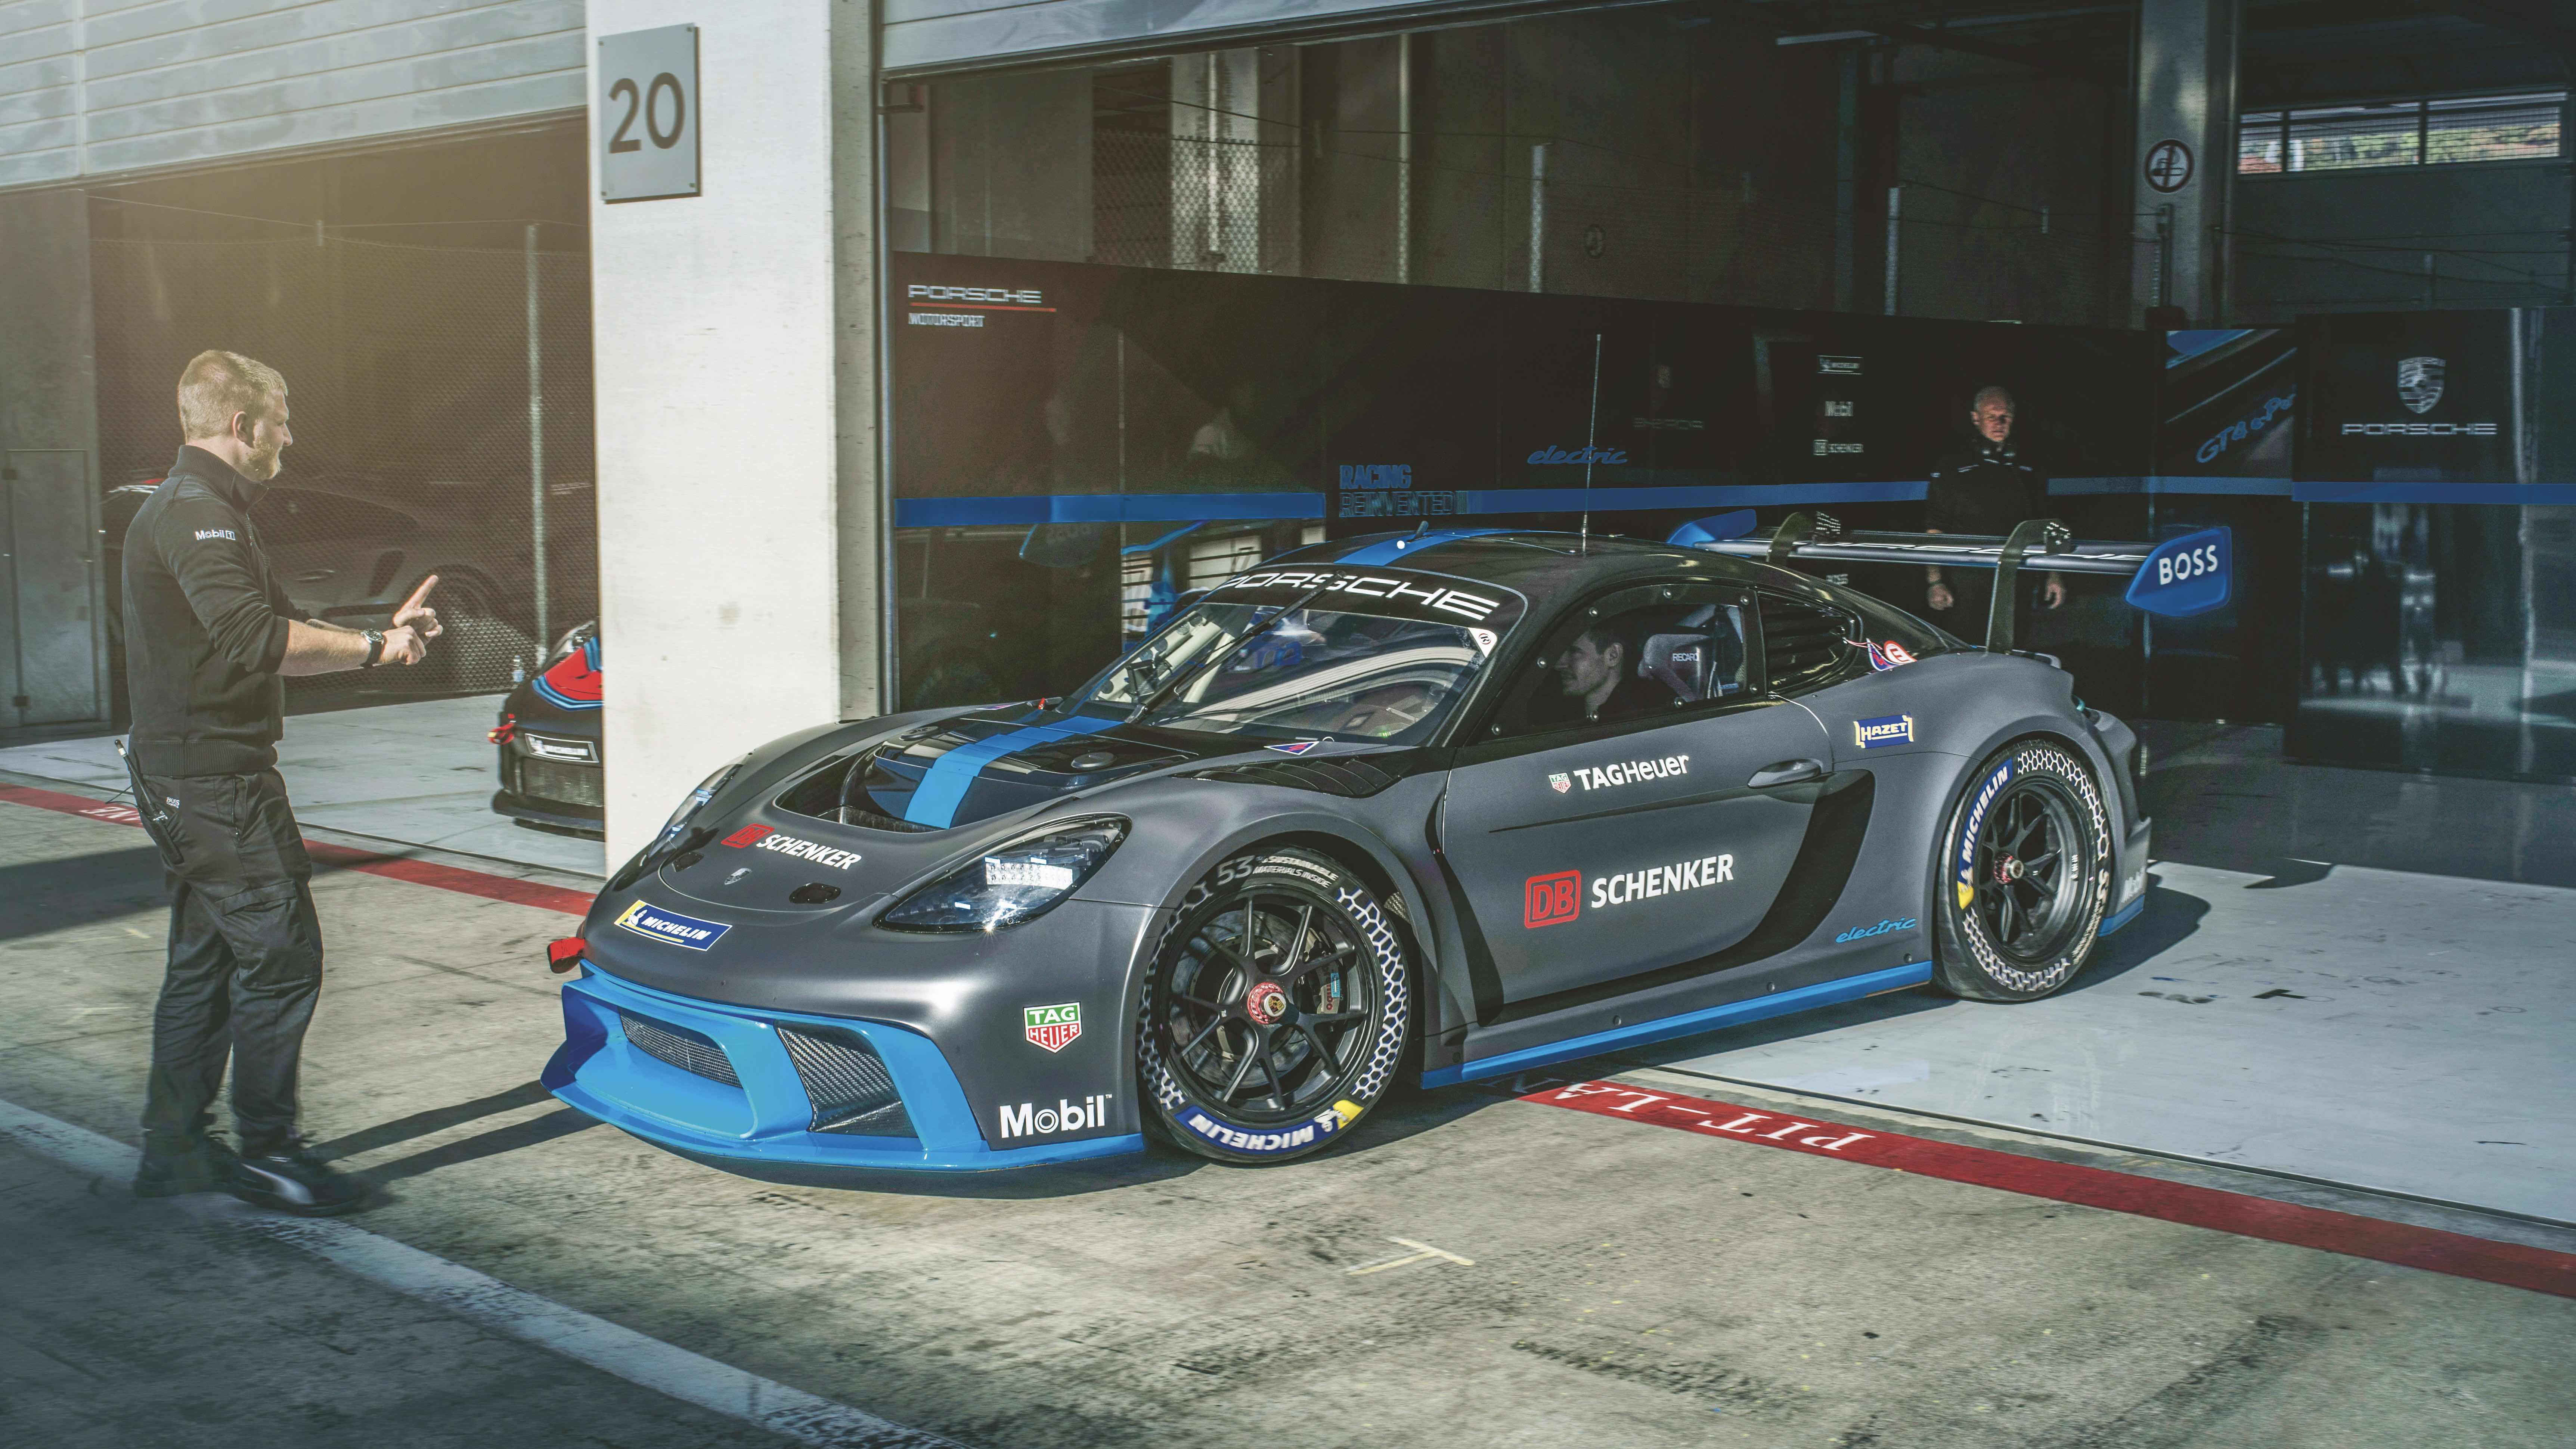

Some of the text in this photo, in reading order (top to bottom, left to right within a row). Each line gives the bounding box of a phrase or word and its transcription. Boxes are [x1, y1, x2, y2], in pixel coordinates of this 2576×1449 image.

[608, 72, 685, 154] 20
[908, 285, 1042, 303] PORSCHE
[2342, 423, 2497, 435] PORSCHE
[1527, 446, 1627, 464] electric
[1339, 465, 1411, 489] RACING
[1339, 491, 1454, 517] REINVENTED
[195, 530, 224, 540] Mobil
[2159, 545, 2217, 585] BOSS
[1861, 722, 1907, 741] HAZET
[1552, 774, 1567, 782] TAG
[1553, 781, 1569, 792] HEUER
[1962, 766, 2008, 864] MICHELIN
[756, 834, 862, 870] SCHENKER
[1532, 853, 1734, 920] DB SCHENKER
[641, 916, 712, 940] MICHELIN
[1835, 917, 1916, 943] electric
[1029, 1006, 1076, 1024] TAG
[1029, 1024, 1078, 1048] HEUER
[1000, 1095, 1105, 1138] Mobil
[1188, 1114, 1314, 1150] MICHELIN
